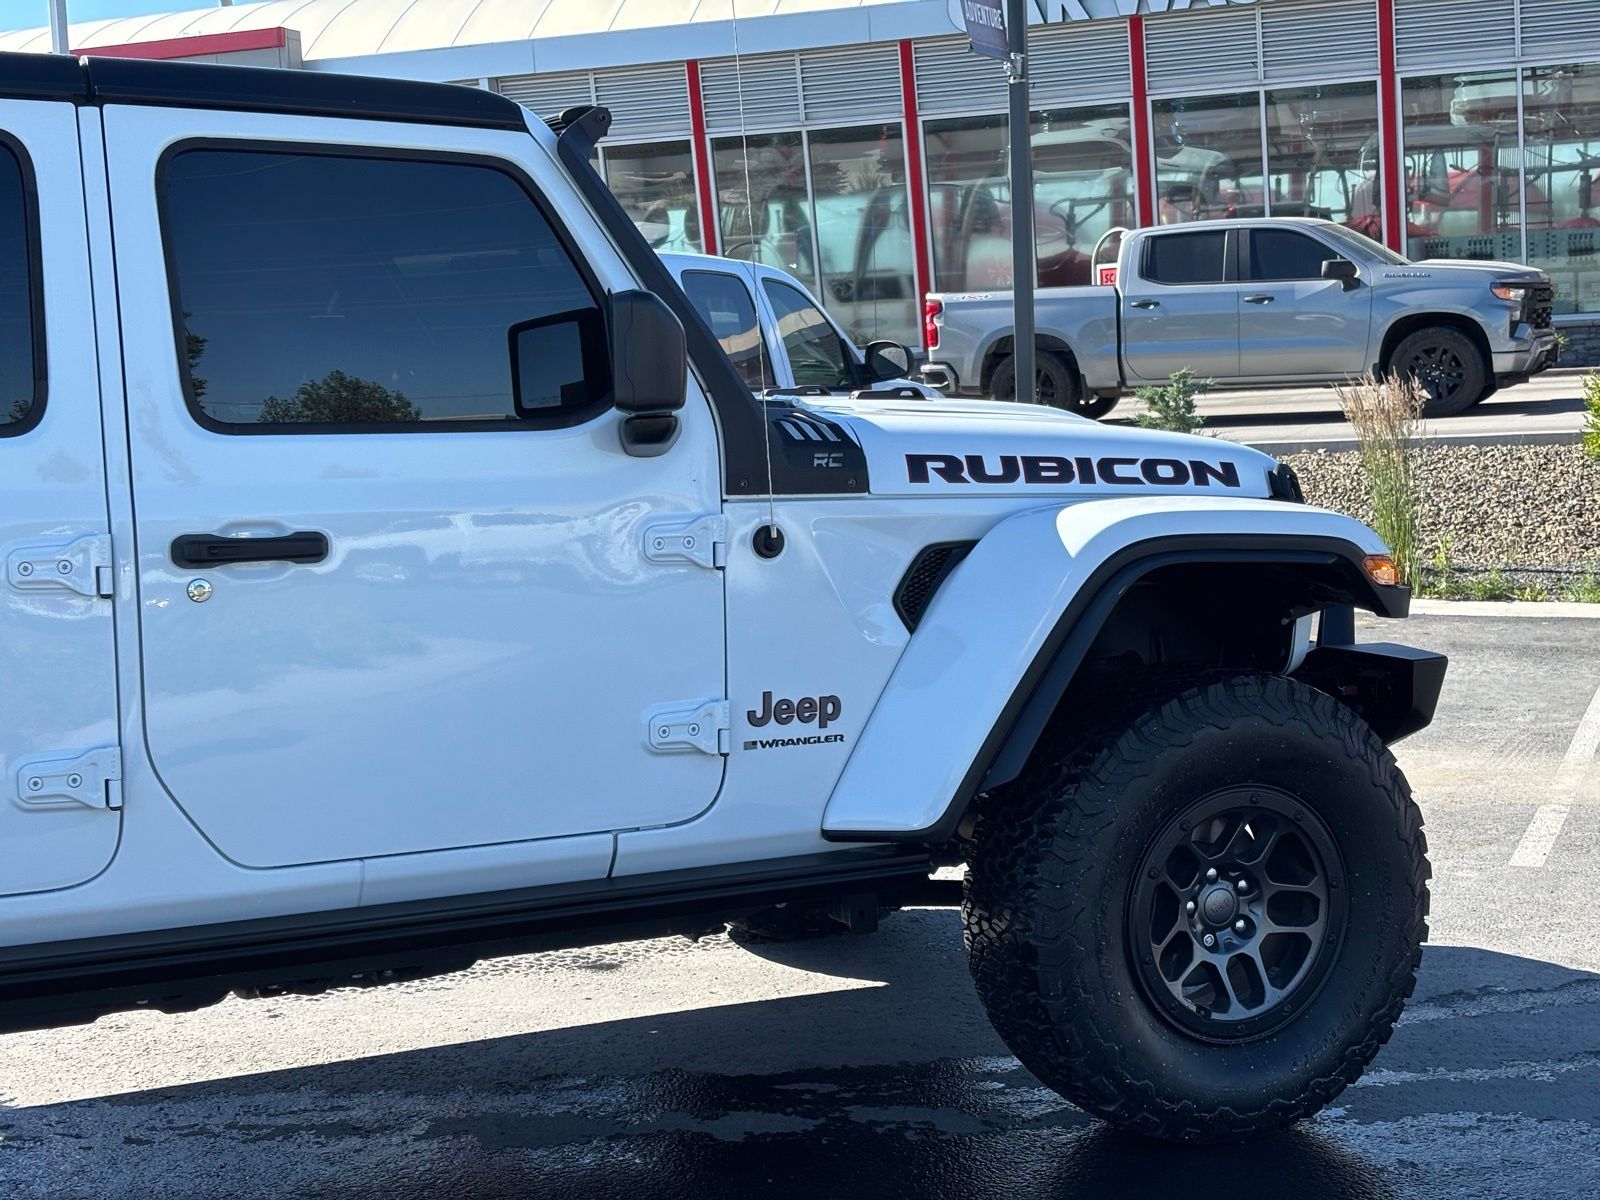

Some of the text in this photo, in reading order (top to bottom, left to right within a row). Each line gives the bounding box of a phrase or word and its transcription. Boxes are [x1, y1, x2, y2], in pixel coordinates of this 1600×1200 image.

[963, 0, 1004, 30] ADVENTURE
[1104, 273, 1115, 284] SC
[813, 452, 844, 468] RC
[904, 453, 1241, 488] RUBICON
[746, 690, 842, 729] Jeep
[758, 734, 845, 749] WRANGLER
